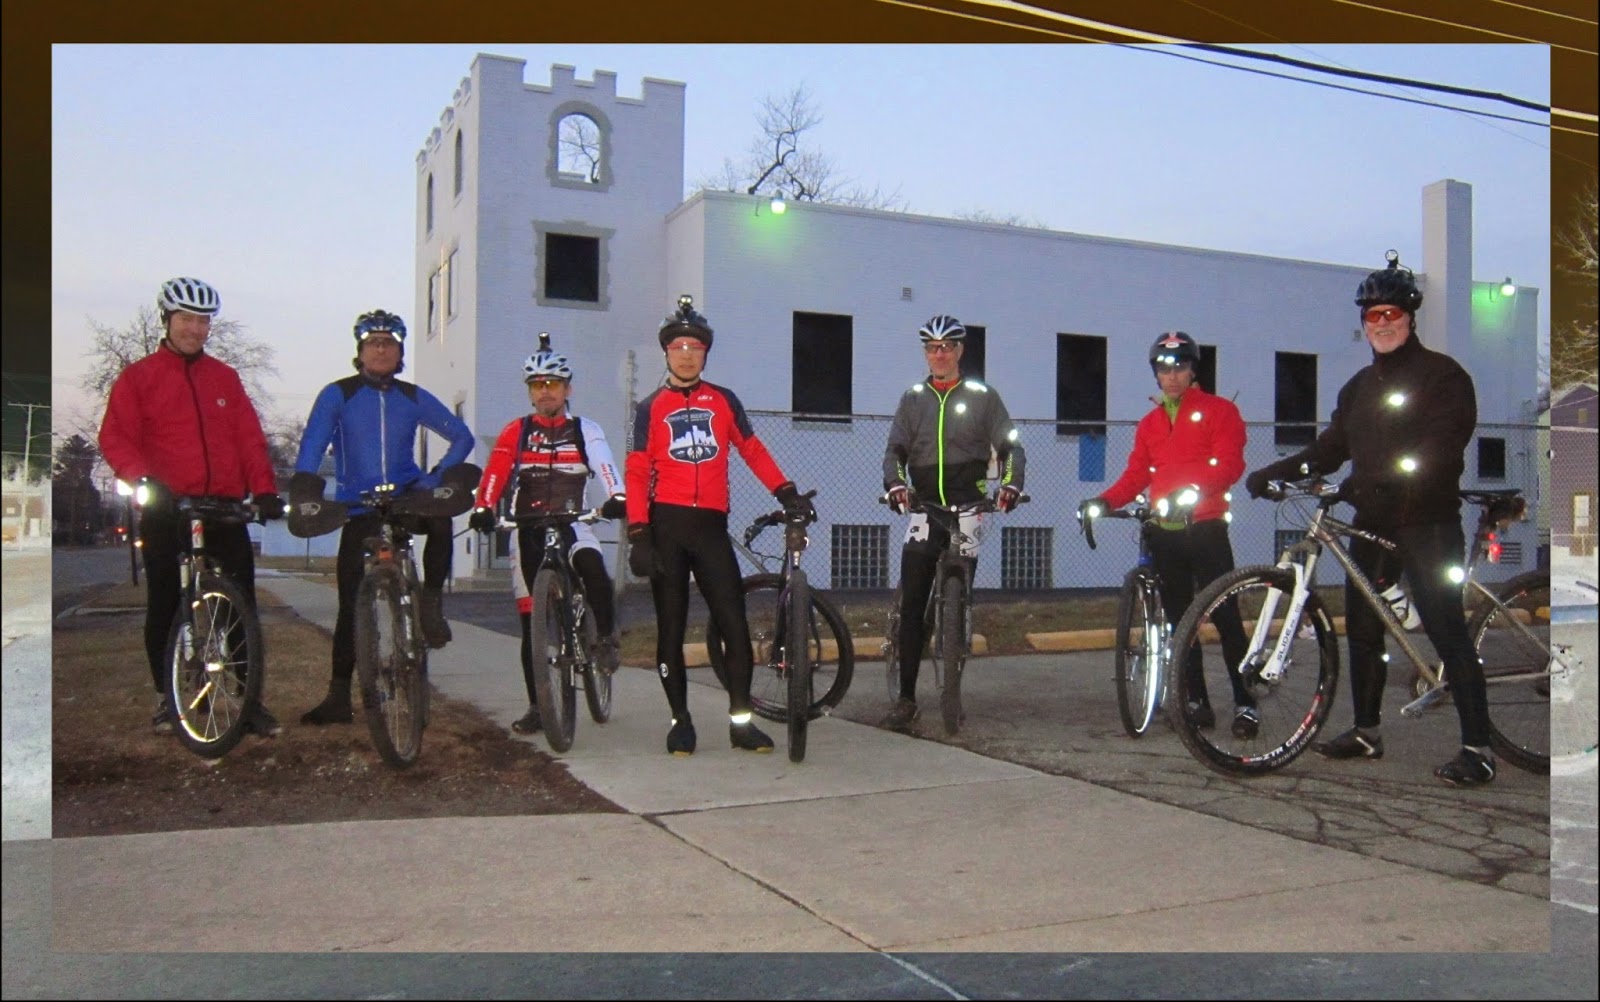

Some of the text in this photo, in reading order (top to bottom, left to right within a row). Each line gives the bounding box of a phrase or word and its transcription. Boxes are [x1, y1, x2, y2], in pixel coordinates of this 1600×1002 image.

[1276, 629, 1293, 661] SLIDE
[1262, 722, 1306, 761] ZTR CREST
